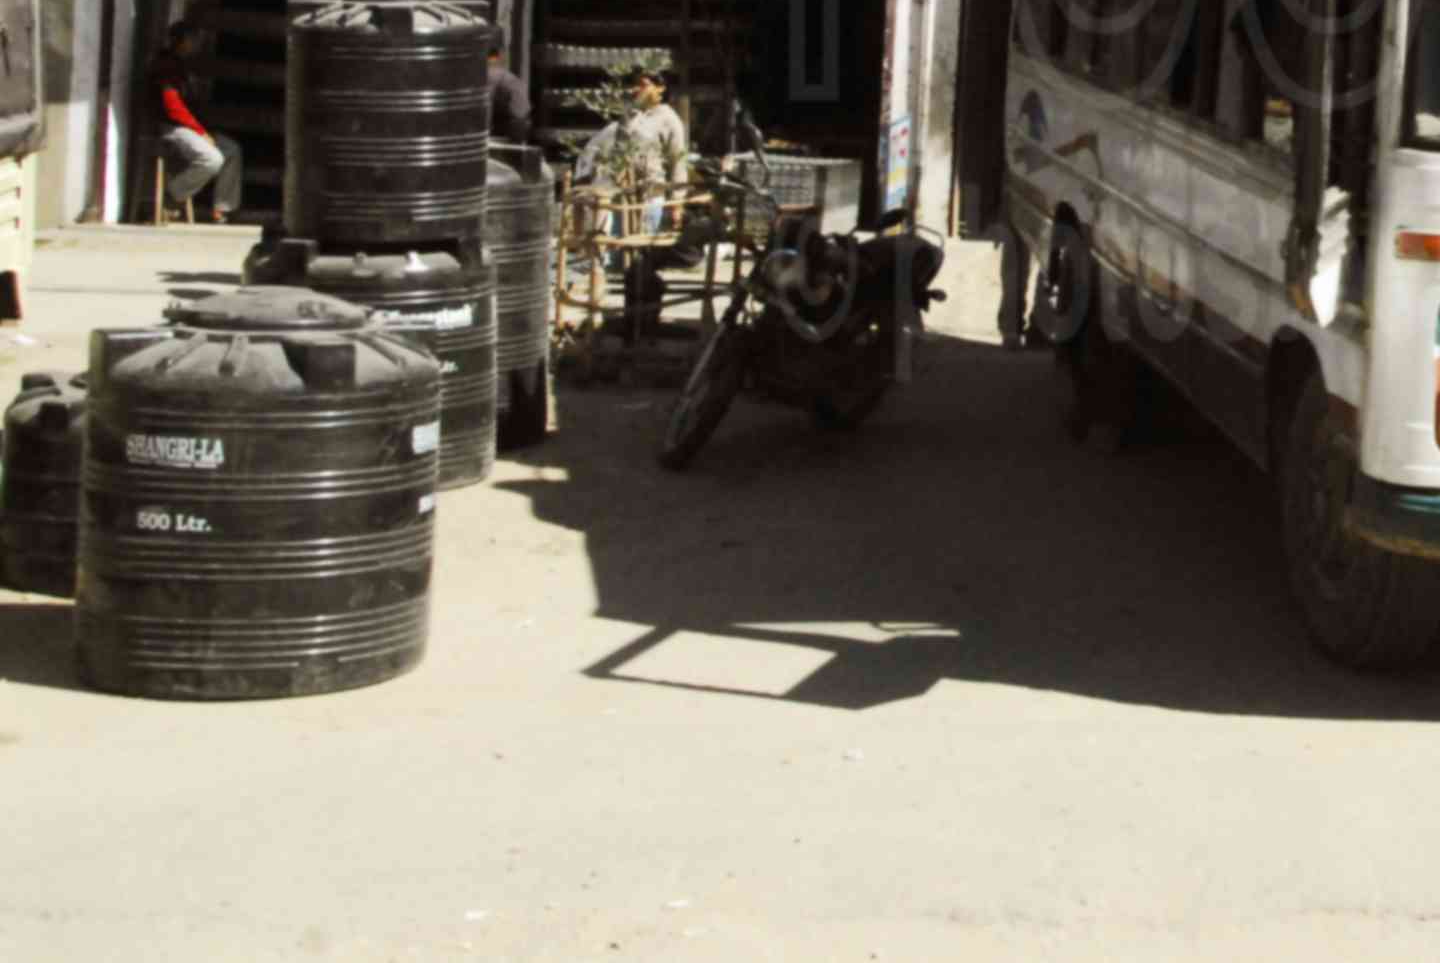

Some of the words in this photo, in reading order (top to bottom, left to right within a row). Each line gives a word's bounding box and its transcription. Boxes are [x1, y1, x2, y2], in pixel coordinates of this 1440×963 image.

[126, 434, 224, 463] SHANGRI-LA
[136, 510, 170, 532] 500
[176, 512, 212, 532] Ltr.
